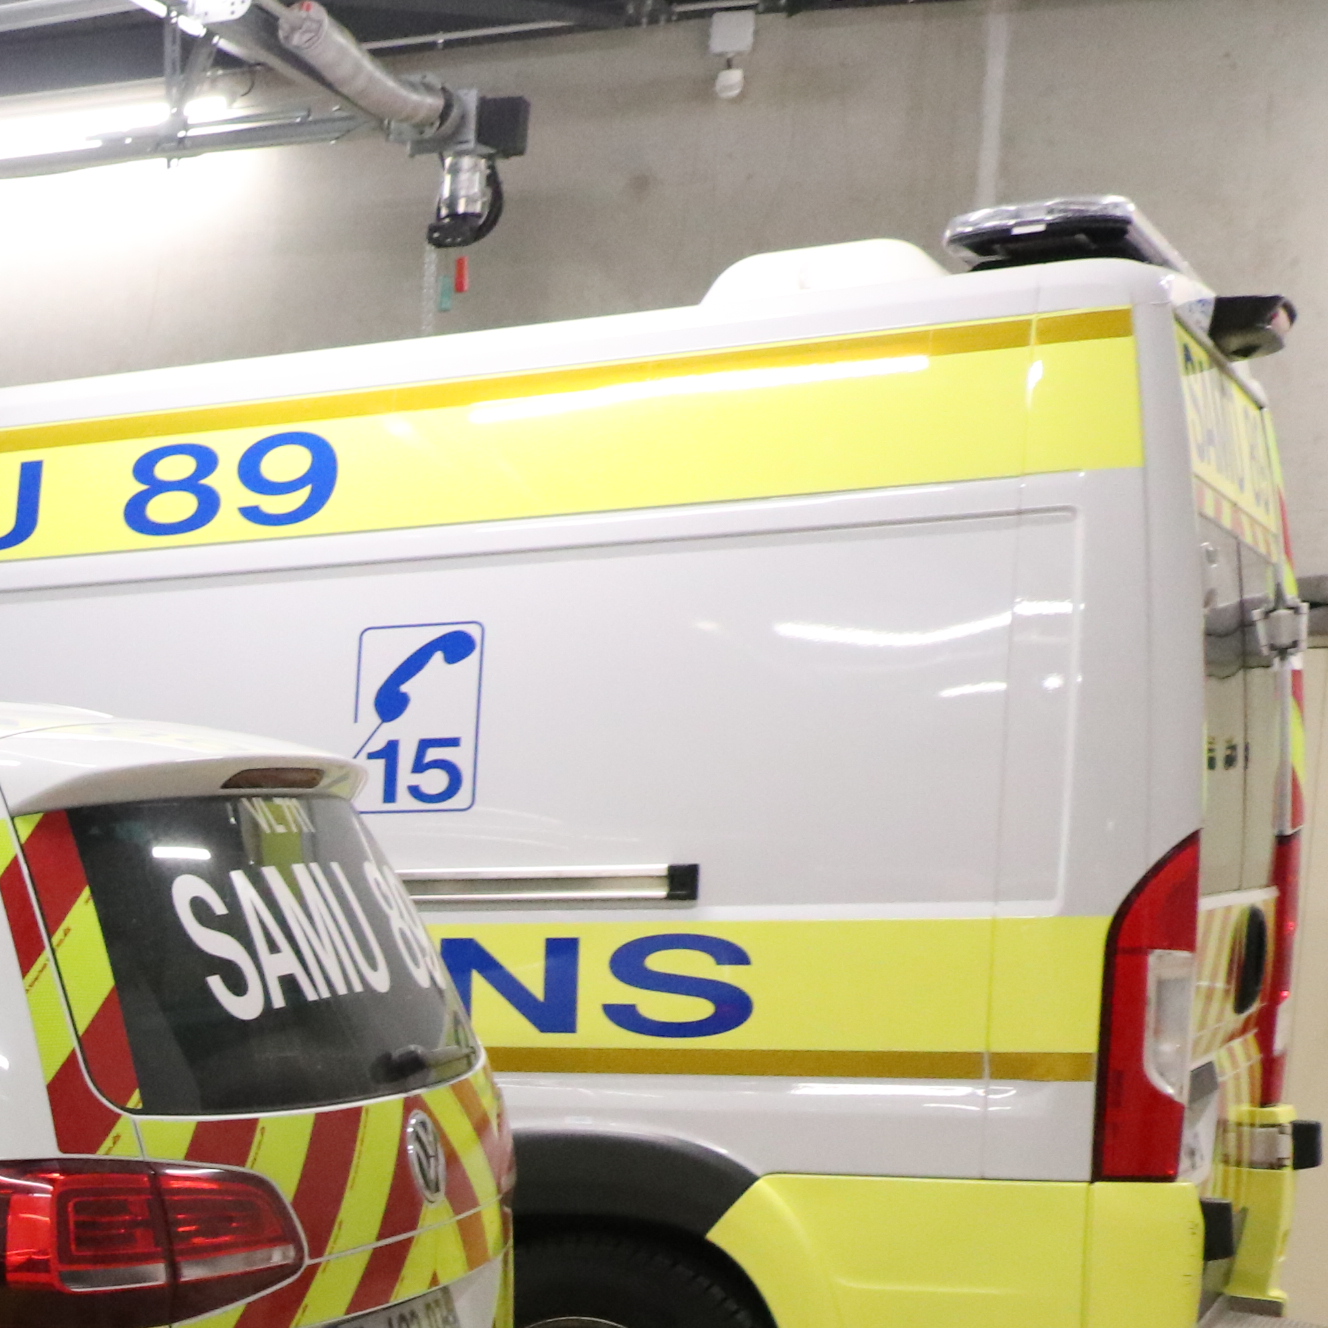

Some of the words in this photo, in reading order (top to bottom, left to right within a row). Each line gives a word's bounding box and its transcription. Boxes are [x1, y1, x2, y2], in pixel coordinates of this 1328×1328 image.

[123, 430, 339, 537] 89
[366, 735, 463, 804] 15
[171, 861, 390, 1021] SAMU
